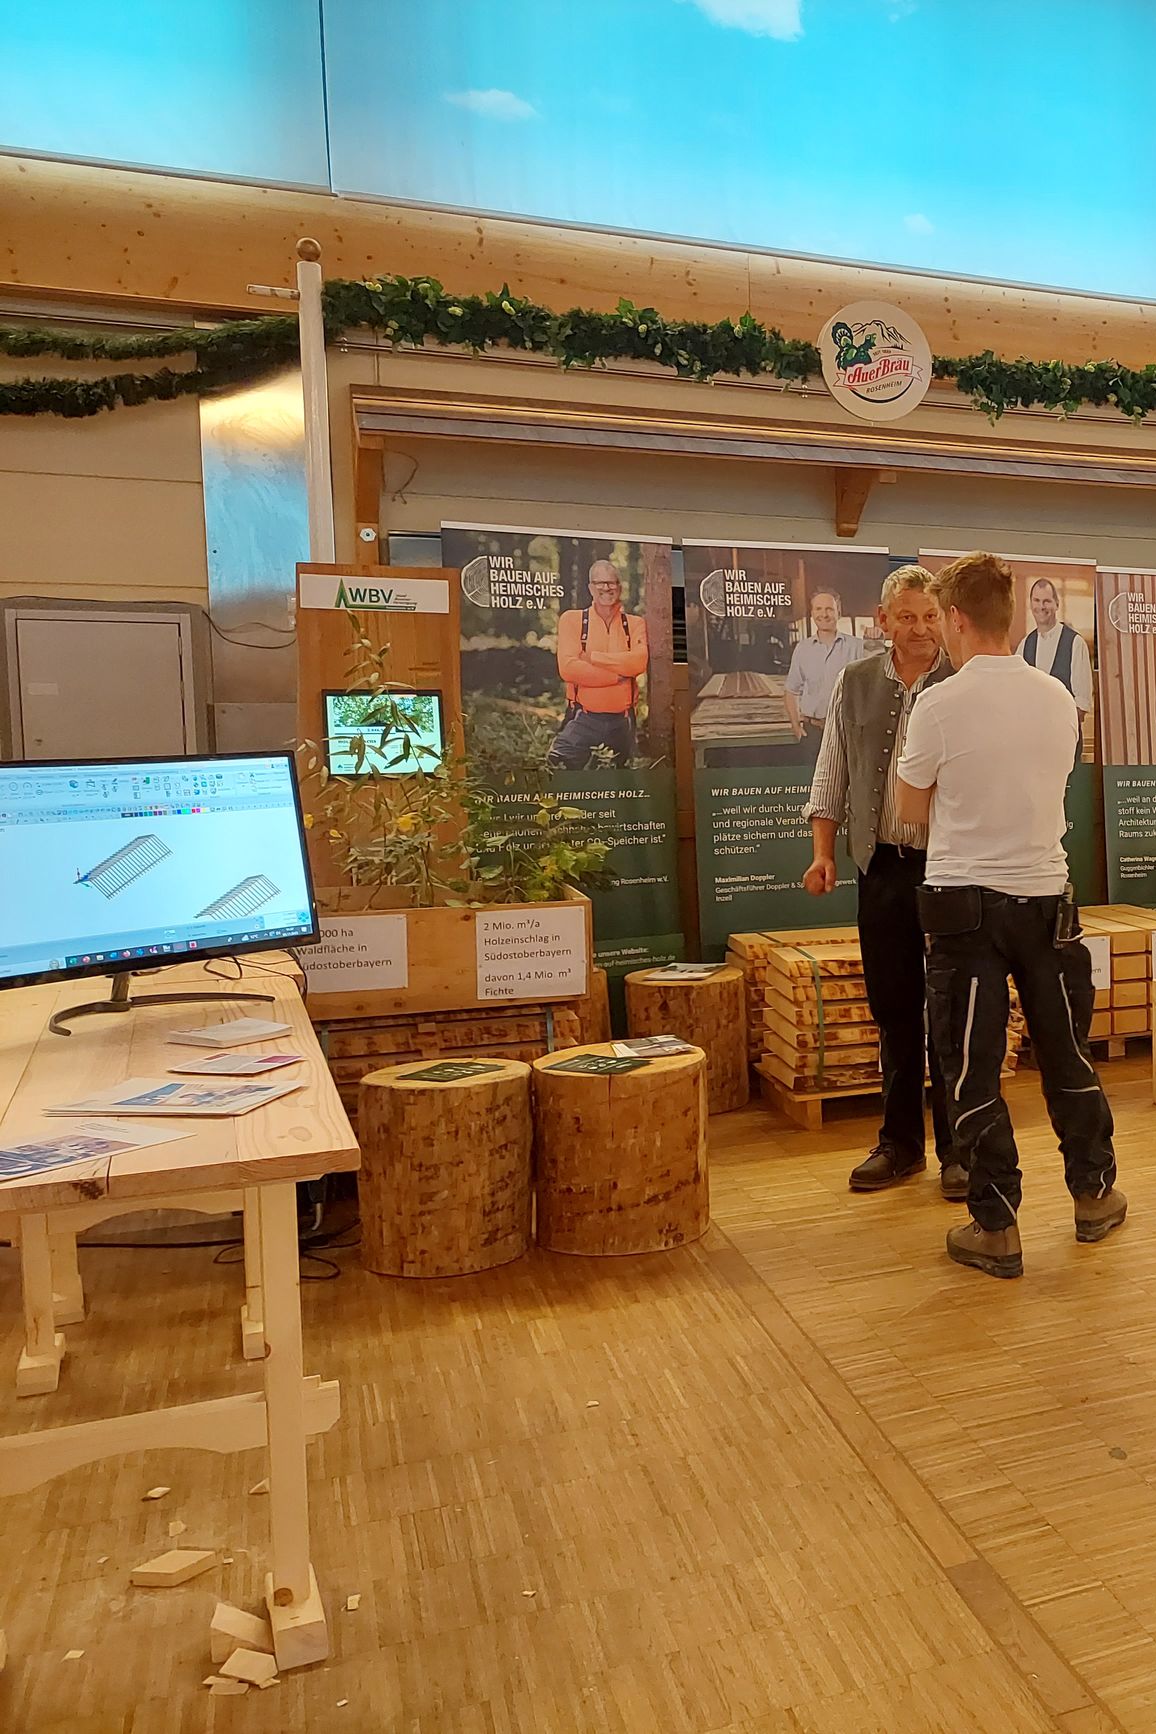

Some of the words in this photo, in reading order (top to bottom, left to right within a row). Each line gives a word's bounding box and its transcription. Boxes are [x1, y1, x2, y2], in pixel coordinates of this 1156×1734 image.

[866, 381, 902, 393] ROSENHEIM
[489, 556, 513, 569] WIR
[490, 570, 531, 583] BAUEN
[534, 572, 557, 584] AUF
[725, 570, 746, 580] WIR
[491, 584, 564, 597] HEIMISCHES
[726, 582, 761, 593] BAUEN
[763, 583, 785, 594] AUF
[349, 588, 393, 604] WBV
[726, 594, 791, 606] HEIMISCHES
[1128, 593, 1144, 602] WIR
[492, 597, 522, 609] HOLZ
[526, 599, 546, 609] e.V.
[1128, 603, 1156, 612] BAUEN
[727, 607, 754, 616] HOLZ
[758, 607, 775, 618] e.V.
[1129, 625, 1149, 633] HOLZ
[557, 791, 615, 801] HEIMISCHES
[599, 810, 615, 818] seit
[743, 804, 757, 814] wir
[759, 804, 784, 813] durch
[713, 820, 730, 829] und
[732, 818, 774, 829] regionale
[1119, 818, 1156, 826] Architektur
[714, 831, 741, 843] plätze
[743, 831, 775, 840] sichern
[778, 830, 795, 838] und
[621, 876, 656, 884] Rosenheim
[715, 875, 749, 884] Maximilian
[751, 874, 775, 882] Doppler
[716, 884, 765, 894] Geschäftsführer
[493, 920, 514, 930] Mio.
[320, 930, 338, 938] 000
[484, 934, 549, 946] Holzeinschlag
[552, 934, 560, 942] in
[484, 948, 572, 961] Südostoberbayern
[485, 972, 514, 983] davon
[518, 972, 532, 982] 1,4
[485, 987, 514, 996] Fichte
